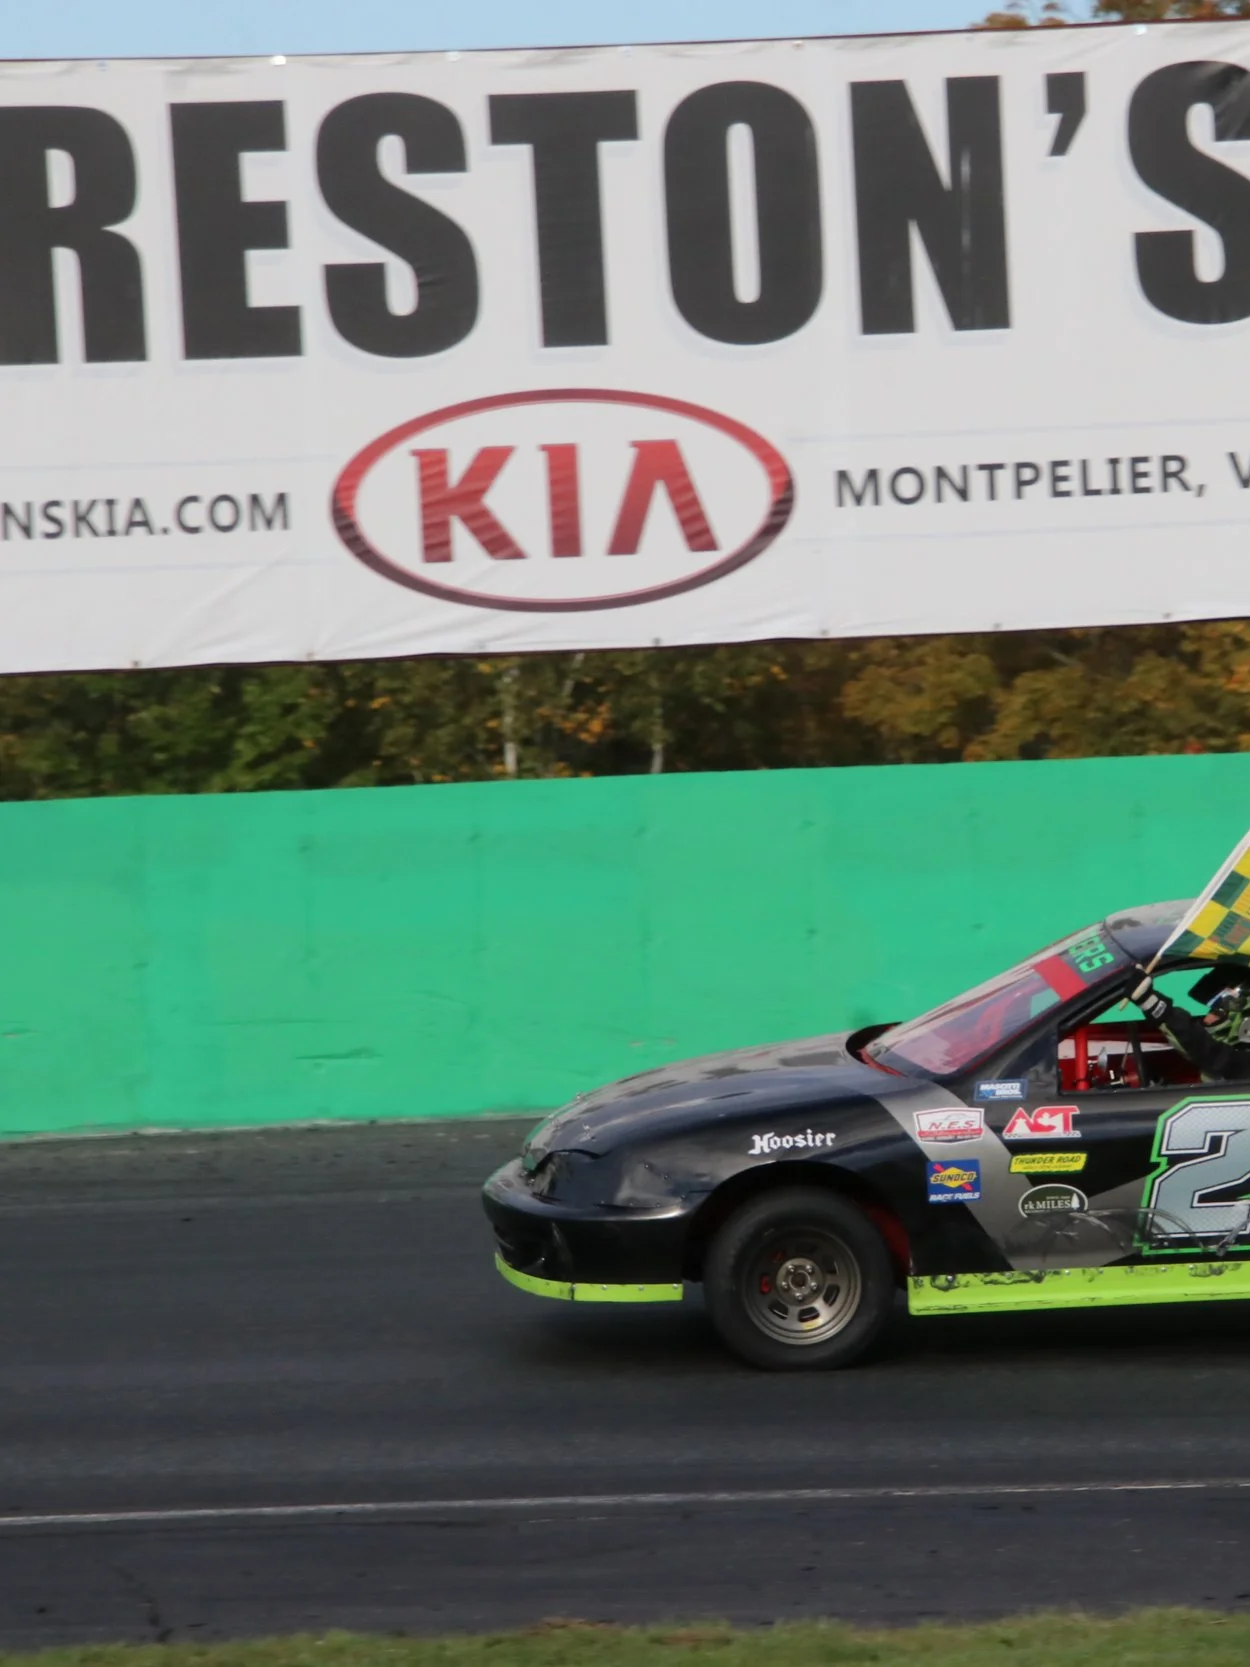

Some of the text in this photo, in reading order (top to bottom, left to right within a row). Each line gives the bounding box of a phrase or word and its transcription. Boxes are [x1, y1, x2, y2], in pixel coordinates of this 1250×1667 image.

[834, 454, 1206, 508] MONTPELIER,
[410, 439, 720, 563] KIA
[0, 492, 290, 541] NSKIA.COM
[1004, 1104, 1080, 1135] ACT
[747, 1128, 837, 1155] Hoosier
[1014, 1154, 1082, 1165] THUNDER ROAD
[931, 1171, 975, 1183] SUNOCO
[929, 1192, 980, 1202] RACE FUELS
